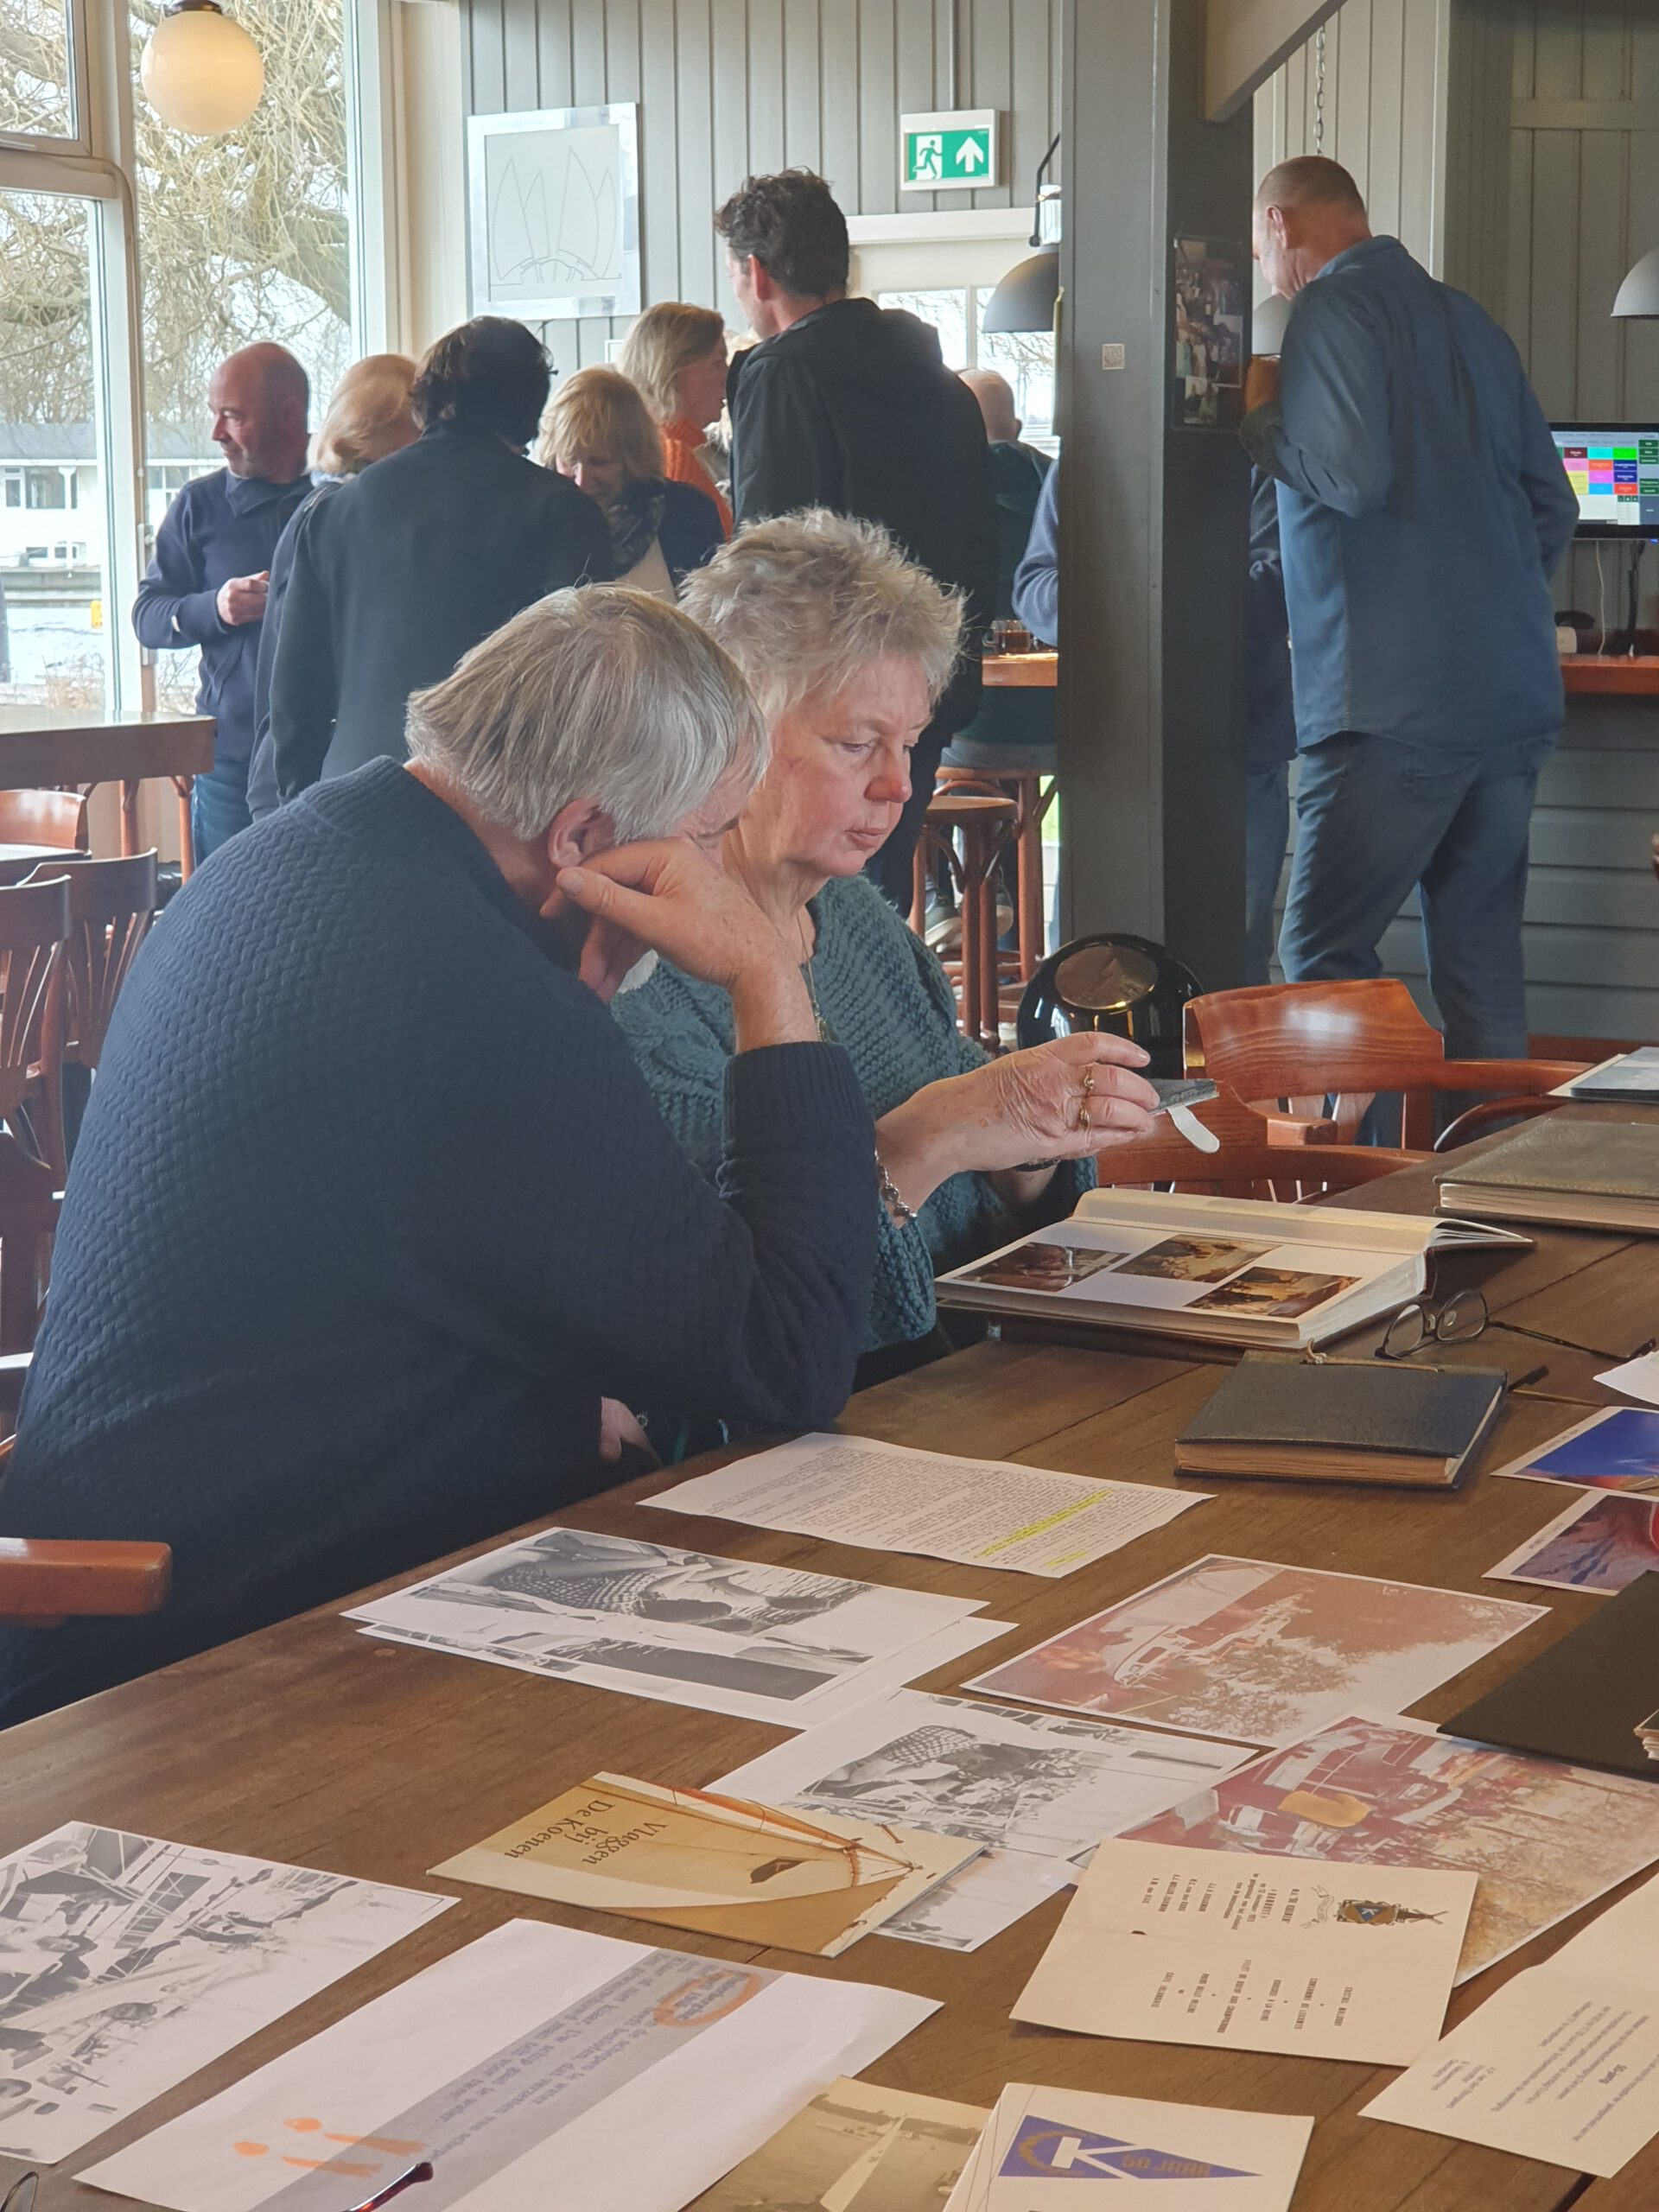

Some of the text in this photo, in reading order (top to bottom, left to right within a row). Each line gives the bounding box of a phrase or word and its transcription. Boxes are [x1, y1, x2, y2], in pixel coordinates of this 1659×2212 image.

[504, 1800, 615, 1859] De Koenen
[564, 1827, 609, 1846] bij
[582, 1821, 669, 1865] Vlaggen
[581, 2039, 631, 2070] schepen
